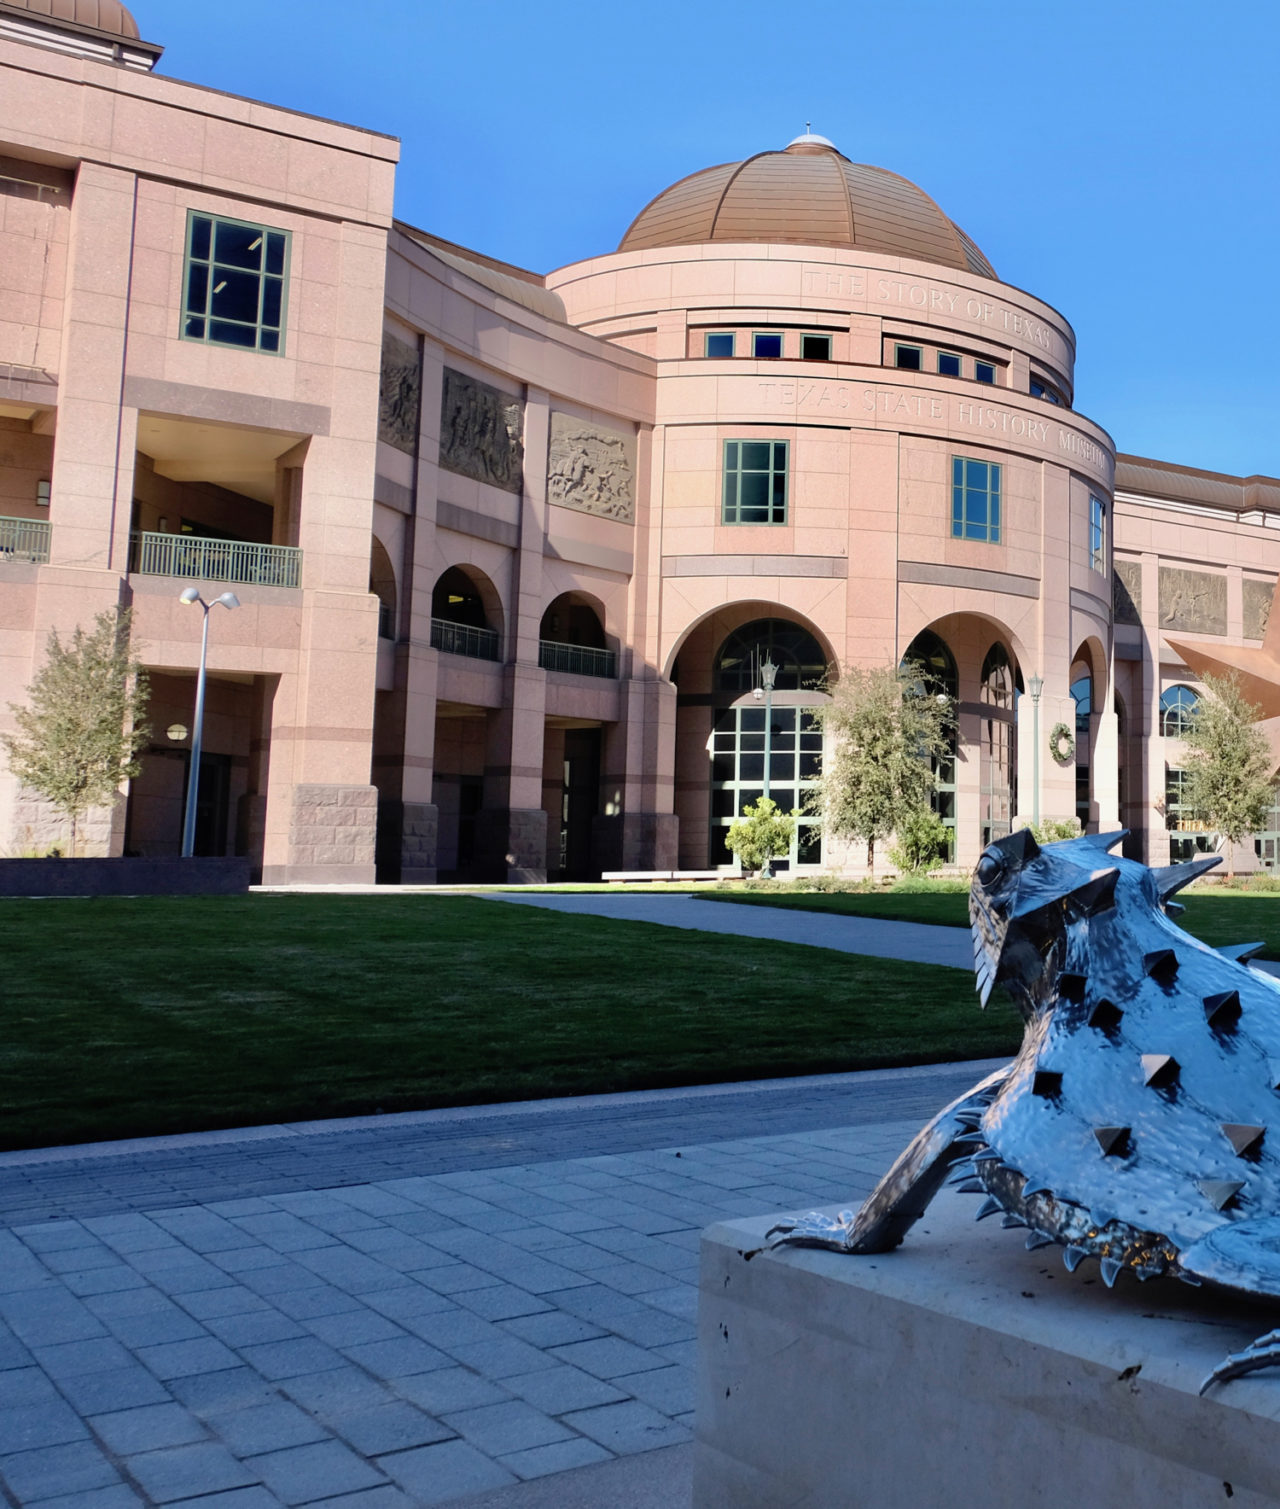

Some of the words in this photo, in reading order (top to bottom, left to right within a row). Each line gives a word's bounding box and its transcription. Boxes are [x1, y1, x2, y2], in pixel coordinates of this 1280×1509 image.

[804, 271, 865, 296] THE
[878, 278, 960, 312] STORY
[966, 298, 995, 322] OF
[1000, 309, 1051, 349] TEXAS
[758, 383, 850, 410] TEXAS
[863, 389, 943, 420] STATE
[959, 402, 1050, 443] HISTORY
[1058, 428, 1106, 470] MUSEUM
